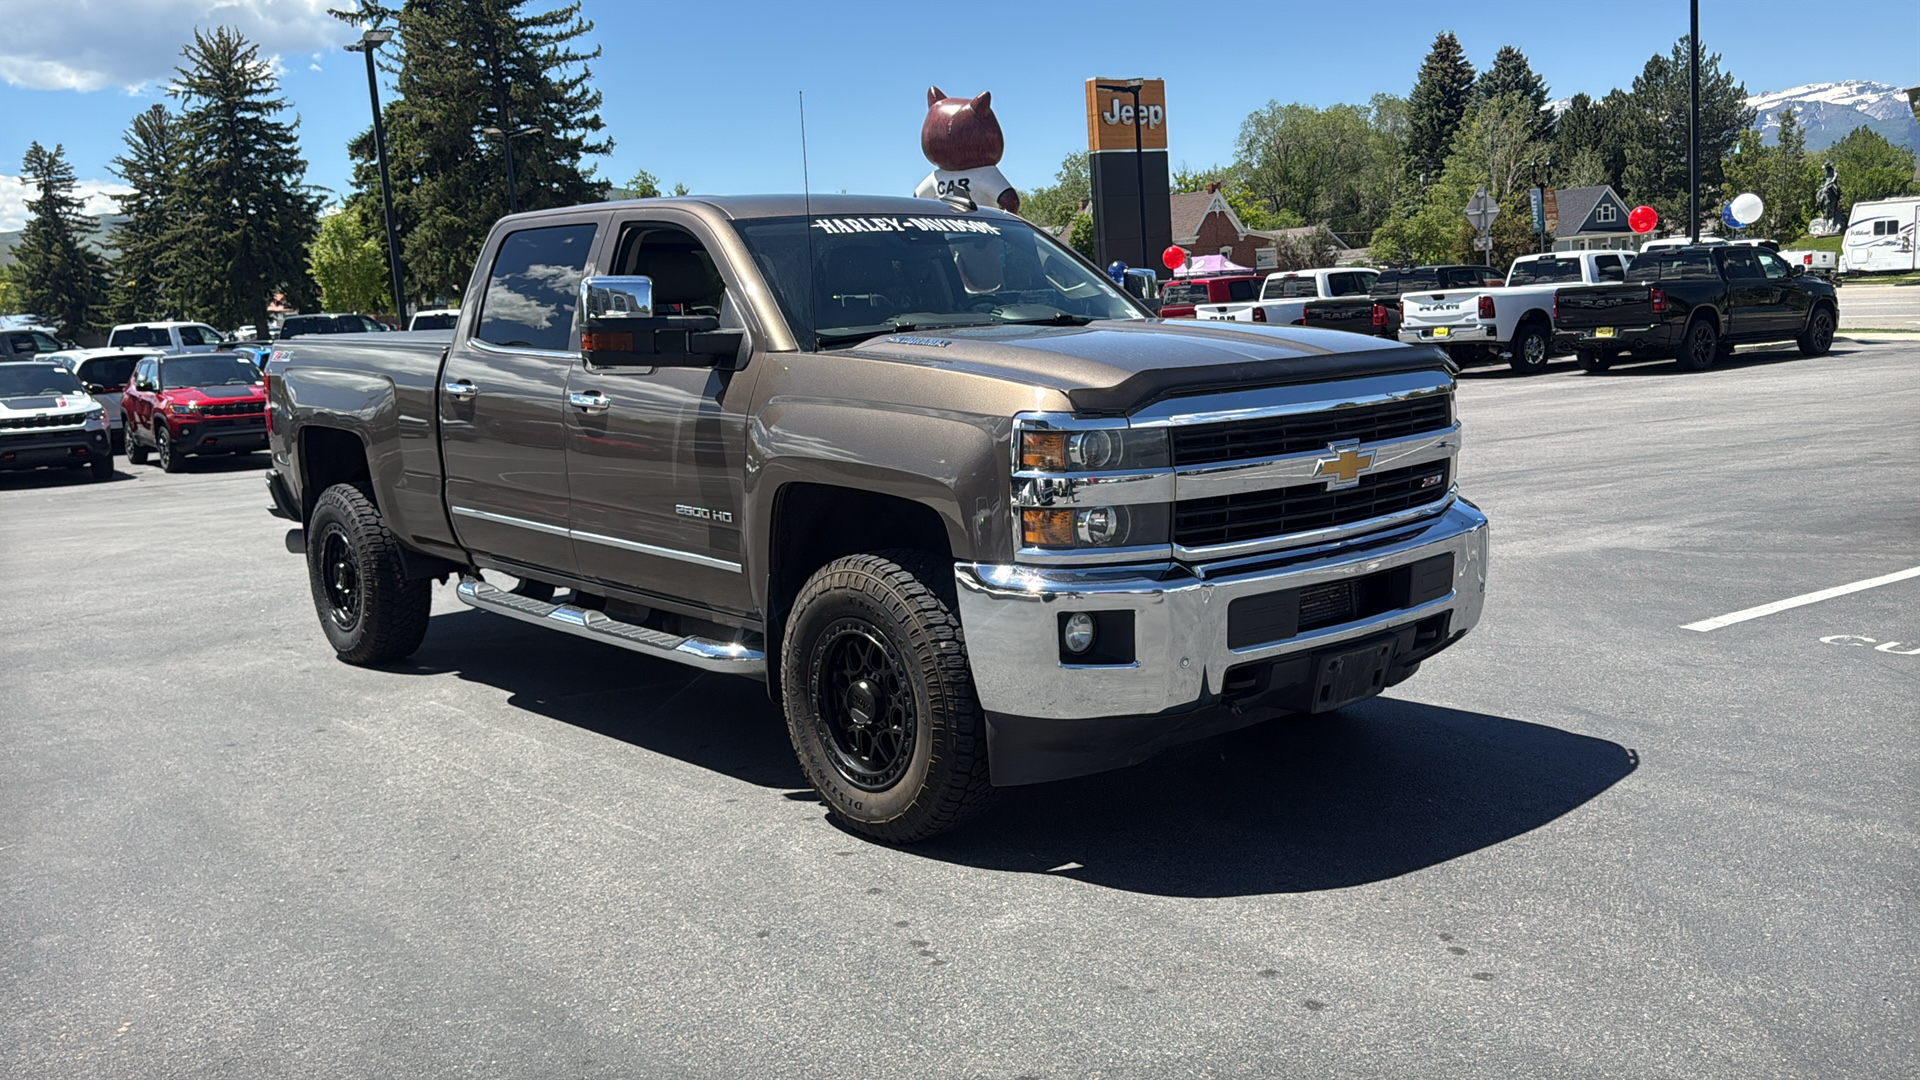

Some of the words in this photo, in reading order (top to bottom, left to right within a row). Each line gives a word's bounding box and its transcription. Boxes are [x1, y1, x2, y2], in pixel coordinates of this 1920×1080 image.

[1103, 98, 1163, 130] Jeep
[937, 178, 971, 196] CAR
[810, 217, 1001, 236] HARLEY-DAVIDSON
[1321, 312, 1352, 320] RAM
[1419, 303, 1459, 312] RAM
[675, 504, 710, 519] 2500
[713, 510, 733, 523] HD
